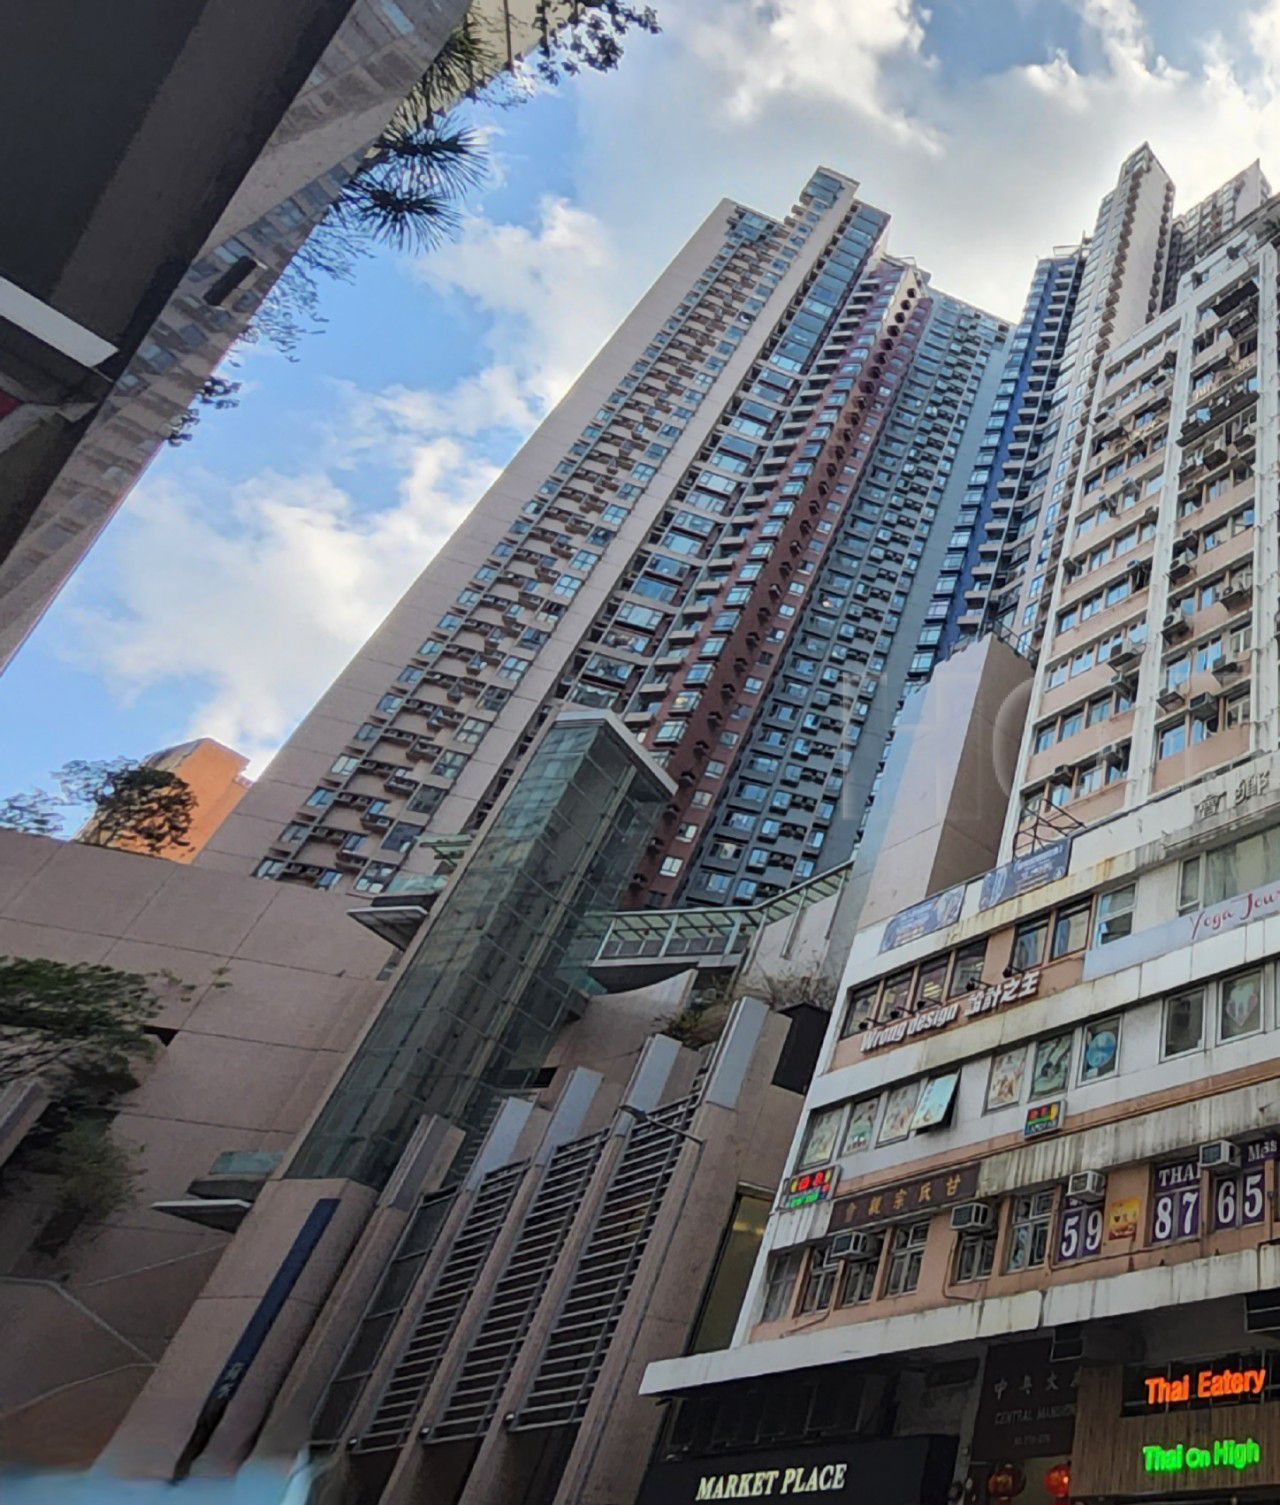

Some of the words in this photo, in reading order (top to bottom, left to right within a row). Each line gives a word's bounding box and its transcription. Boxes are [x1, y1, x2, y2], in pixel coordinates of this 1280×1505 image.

[1189, 910, 1234, 941] Yoga
[1061, 1211, 1103, 1258] 59
[1154, 1191, 1200, 1240] 87
[1145, 1374, 1190, 1405] Thai
[1198, 1369, 1266, 1398] Eatery
[1143, 1443, 1184, 1472] Thai
[1214, 1437, 1260, 1470] High
[695, 1470, 780, 1502] MARKET
[780, 1463, 848, 1495] PLACE
